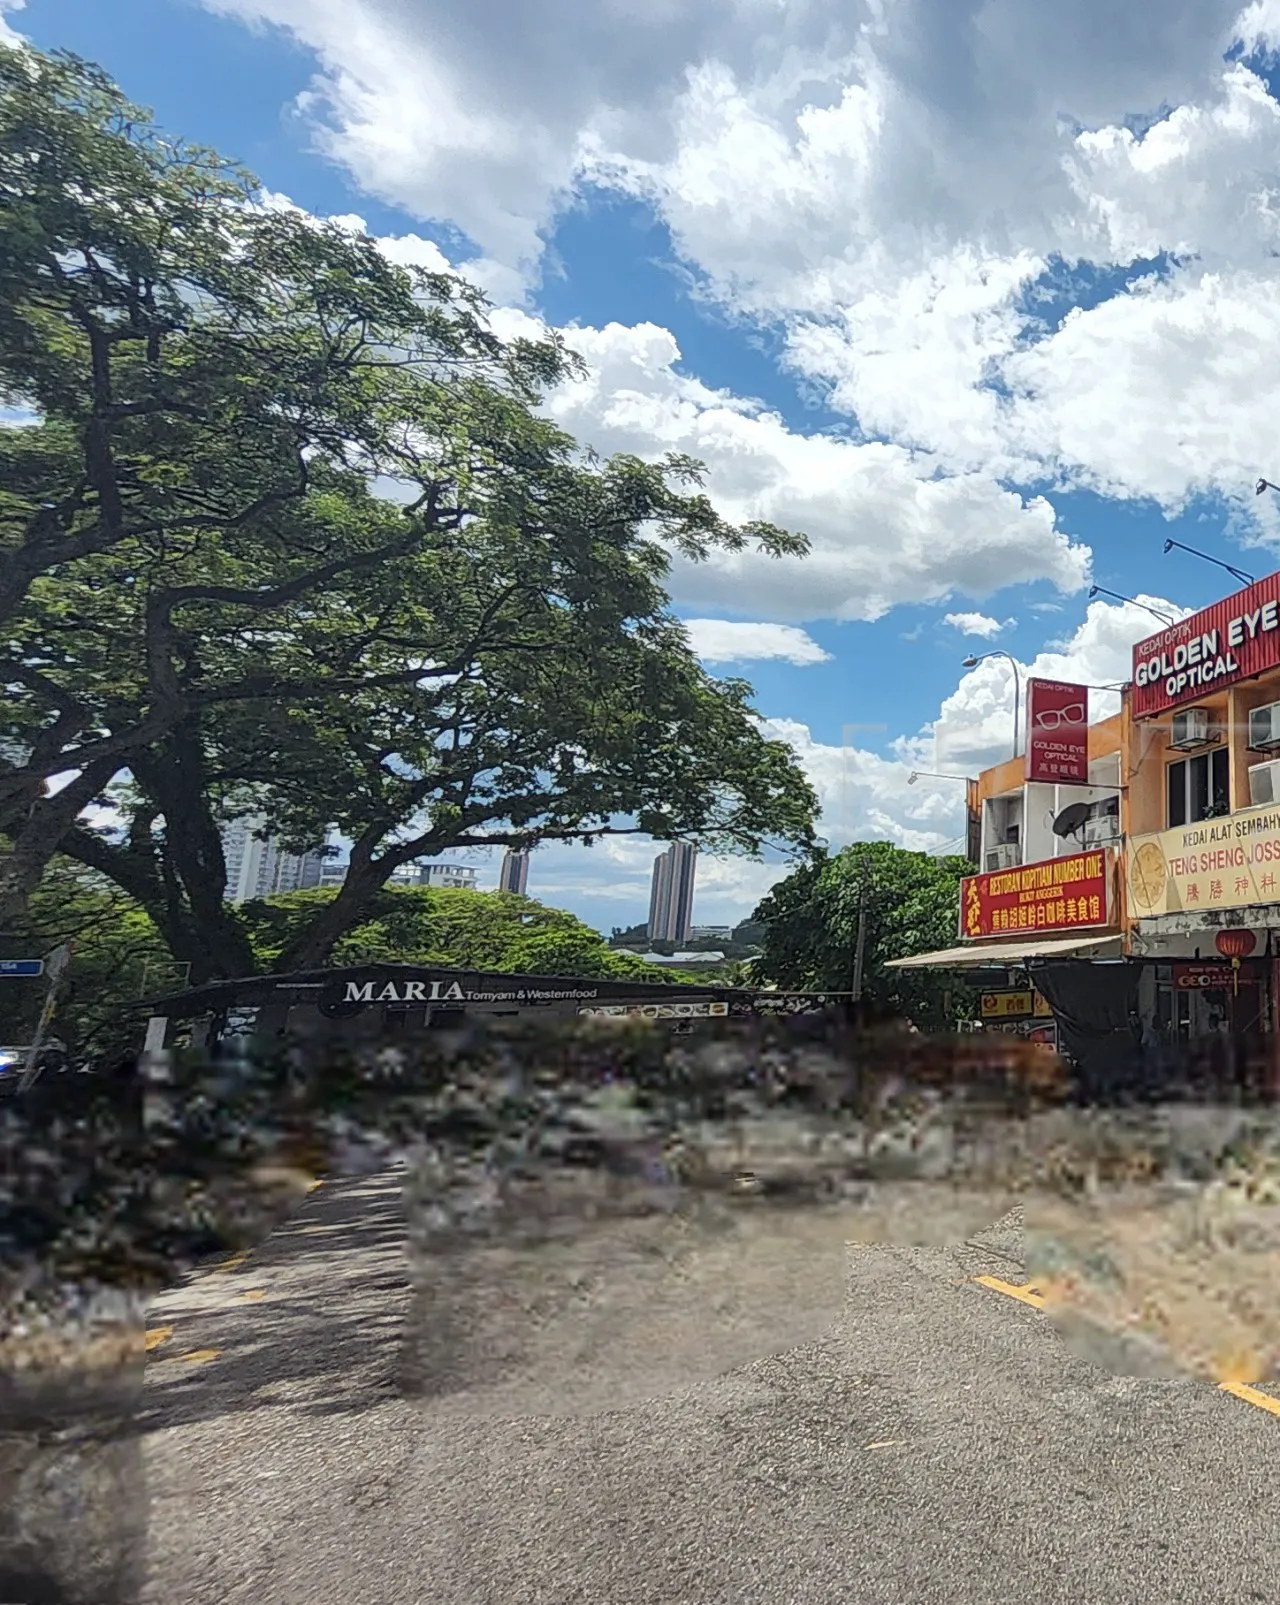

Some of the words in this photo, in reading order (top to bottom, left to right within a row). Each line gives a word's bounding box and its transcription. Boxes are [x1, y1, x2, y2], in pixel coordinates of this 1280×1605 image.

[1135, 628, 1217, 687] GOLDEN
[1228, 600, 1279, 647] EYE
[1138, 636, 1164, 657] KEDAI
[1164, 622, 1192, 646] OPTIK
[1165, 651, 1238, 696] OPTICAL
[1033, 740, 1067, 751] GOLDEN
[1069, 745, 1085, 754] EYE
[1044, 751, 1079, 762] OPTICAL
[1182, 829, 1208, 848] KEDAI
[1210, 823, 1233, 842] ALAT
[989, 872, 1021, 896] RESTORAN
[1022, 865, 1052, 890] KOPITIAM
[1053, 858, 1084, 884] NUMBER
[1086, 854, 1103, 880] ONE
[1169, 856, 1198, 877] TENG
[1200, 846, 1244, 872] SHENG
[1246, 839, 1280, 865] JOSS
[343, 981, 466, 1001] MARIA
[466, 990, 515, 1002] Tomyam
[517, 990, 526, 999] &
